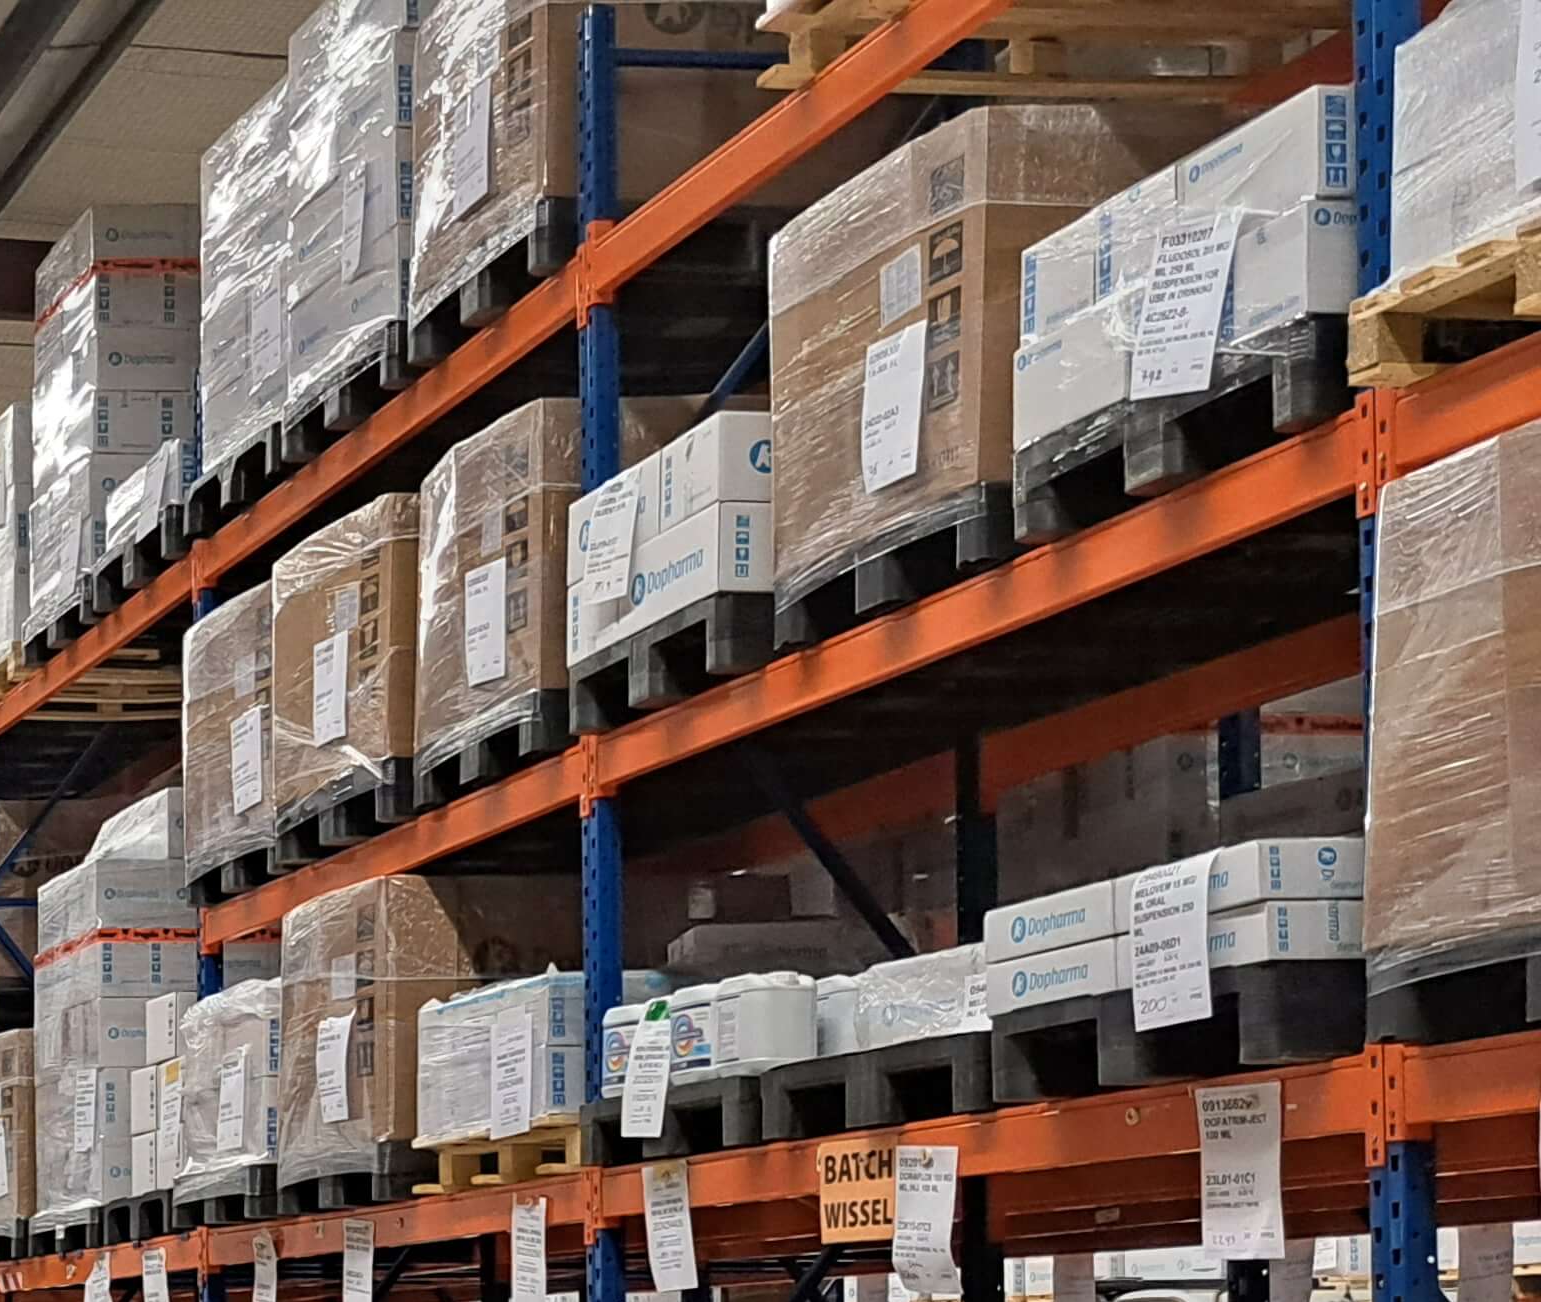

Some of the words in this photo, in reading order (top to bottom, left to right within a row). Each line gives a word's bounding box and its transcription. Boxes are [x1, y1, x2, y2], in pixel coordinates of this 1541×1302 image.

[1151, 272, 1203, 292] SUSPENSION
[1148, 291, 1166, 304] USE
[647, 549, 704, 595] Dopharma
[1133, 905, 1181, 925] SUSPENSION
[1182, 900, 1195, 913] 250
[1145, 896, 1166, 910] ORAL
[1027, 907, 1086, 937] Dopharma
[1028, 961, 1089, 991] Dopharma
[1220, 1129, 1233, 1140] ML
[824, 1149, 893, 1185] BATCH
[824, 1198, 894, 1230] WISSEL
